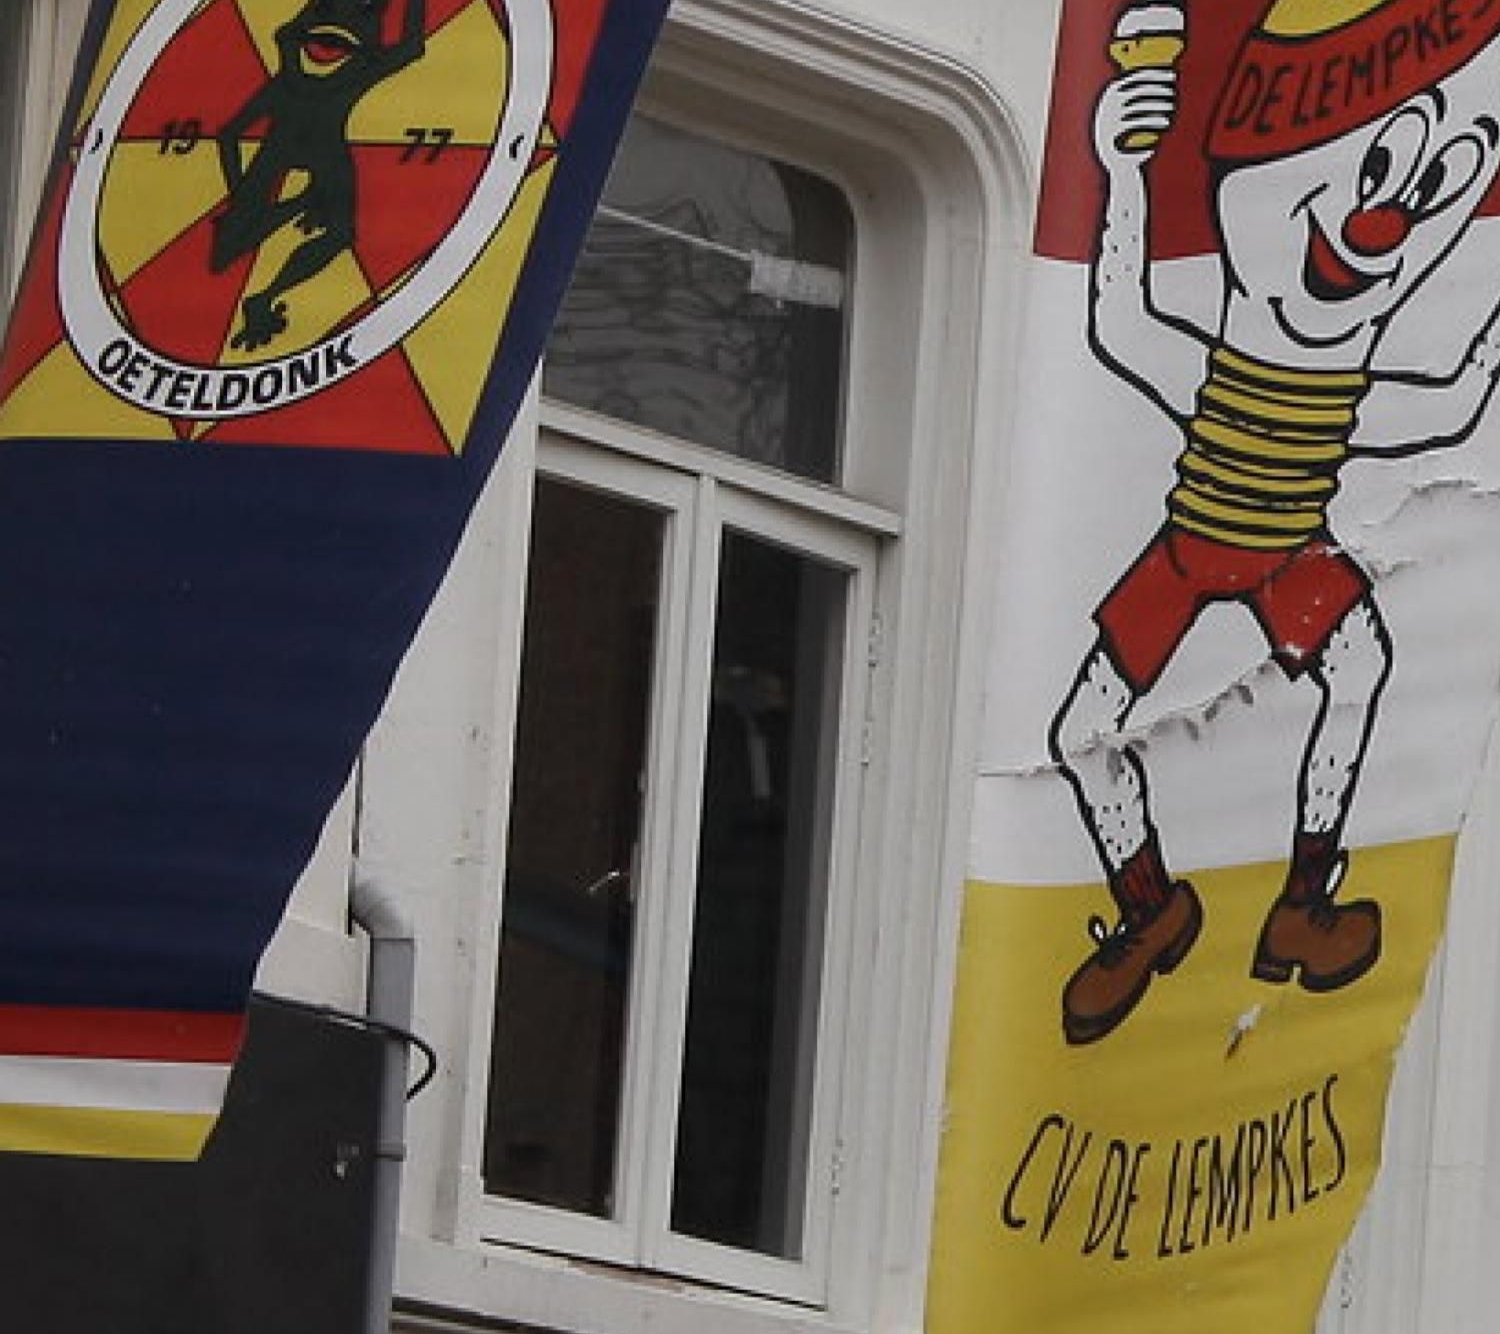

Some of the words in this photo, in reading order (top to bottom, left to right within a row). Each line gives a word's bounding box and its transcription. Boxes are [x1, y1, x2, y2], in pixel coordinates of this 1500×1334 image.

[157, 120, 200, 155] 19
[402, 129, 454, 163] 77
[98, 337, 357, 411] OETELDONK
[1003, 1114, 1092, 1242] CV
[1081, 1139, 1151, 1260] DE
[1158, 1074, 1346, 1258] LEMPKES
